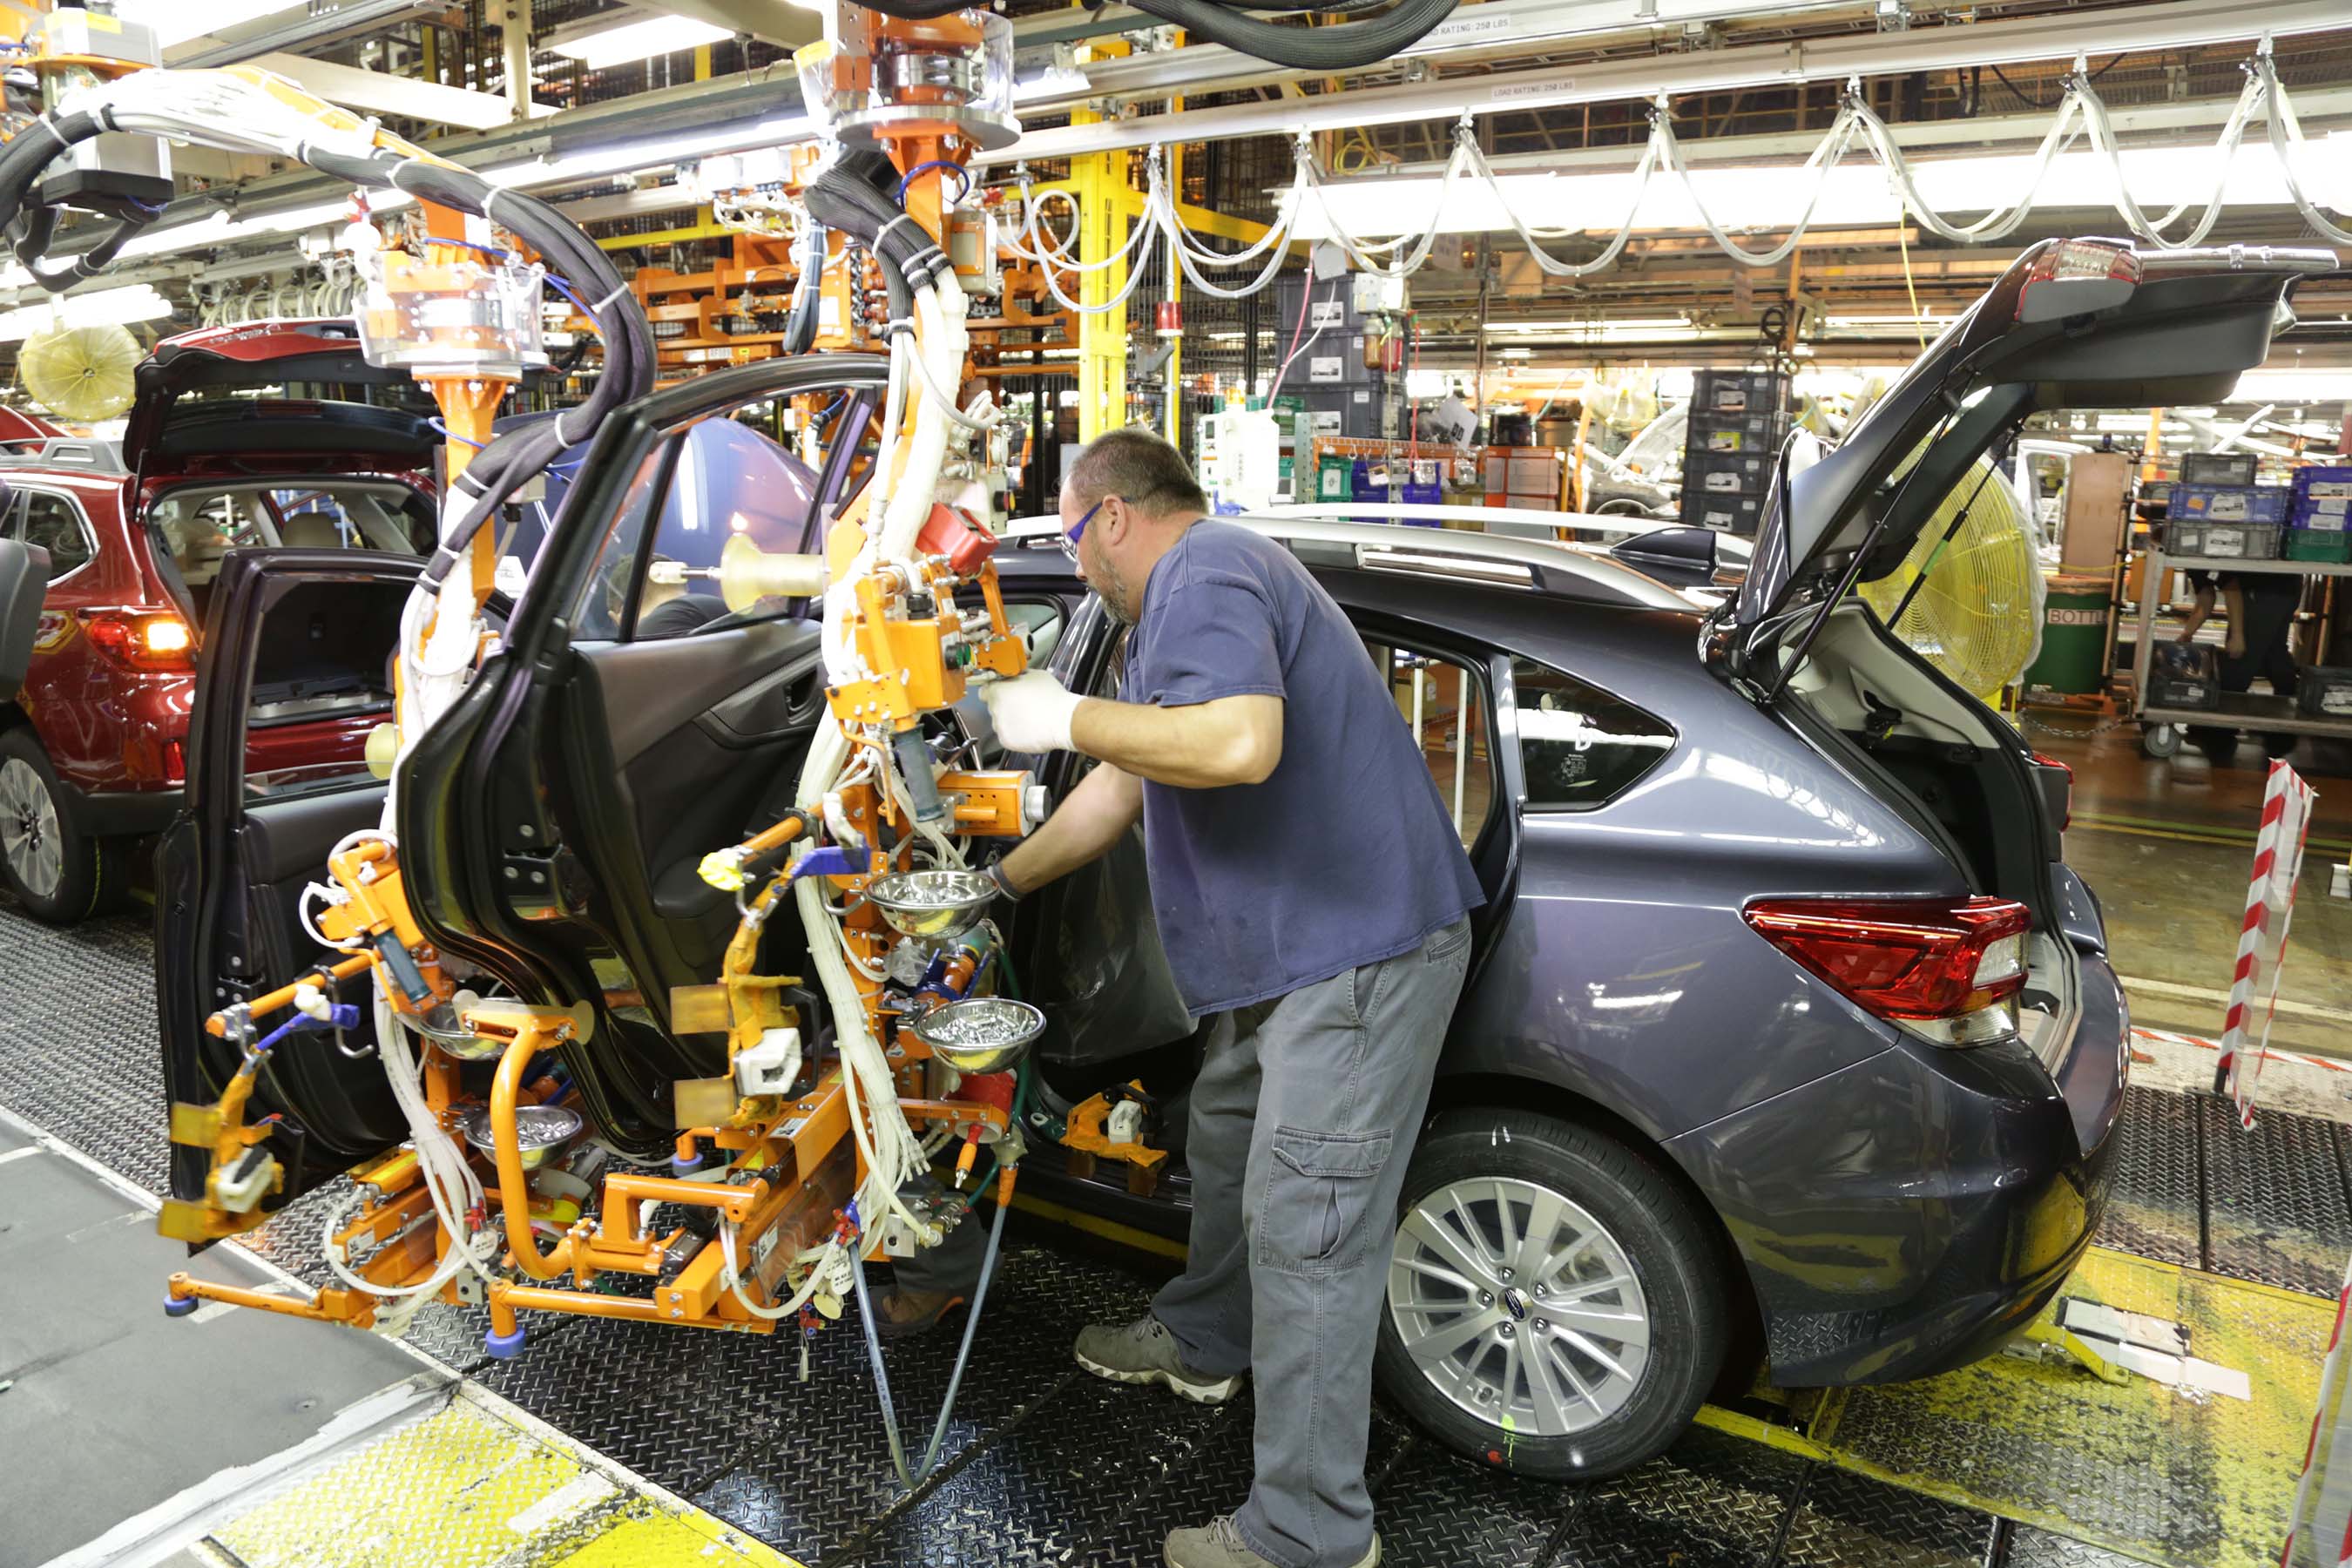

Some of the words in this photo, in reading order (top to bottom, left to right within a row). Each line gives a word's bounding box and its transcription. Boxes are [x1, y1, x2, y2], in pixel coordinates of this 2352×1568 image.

[1476, 21, 1490, 30] 250
[1493, 18, 1509, 29] LBS
[2051, 610, 2105, 623] BOTTL
